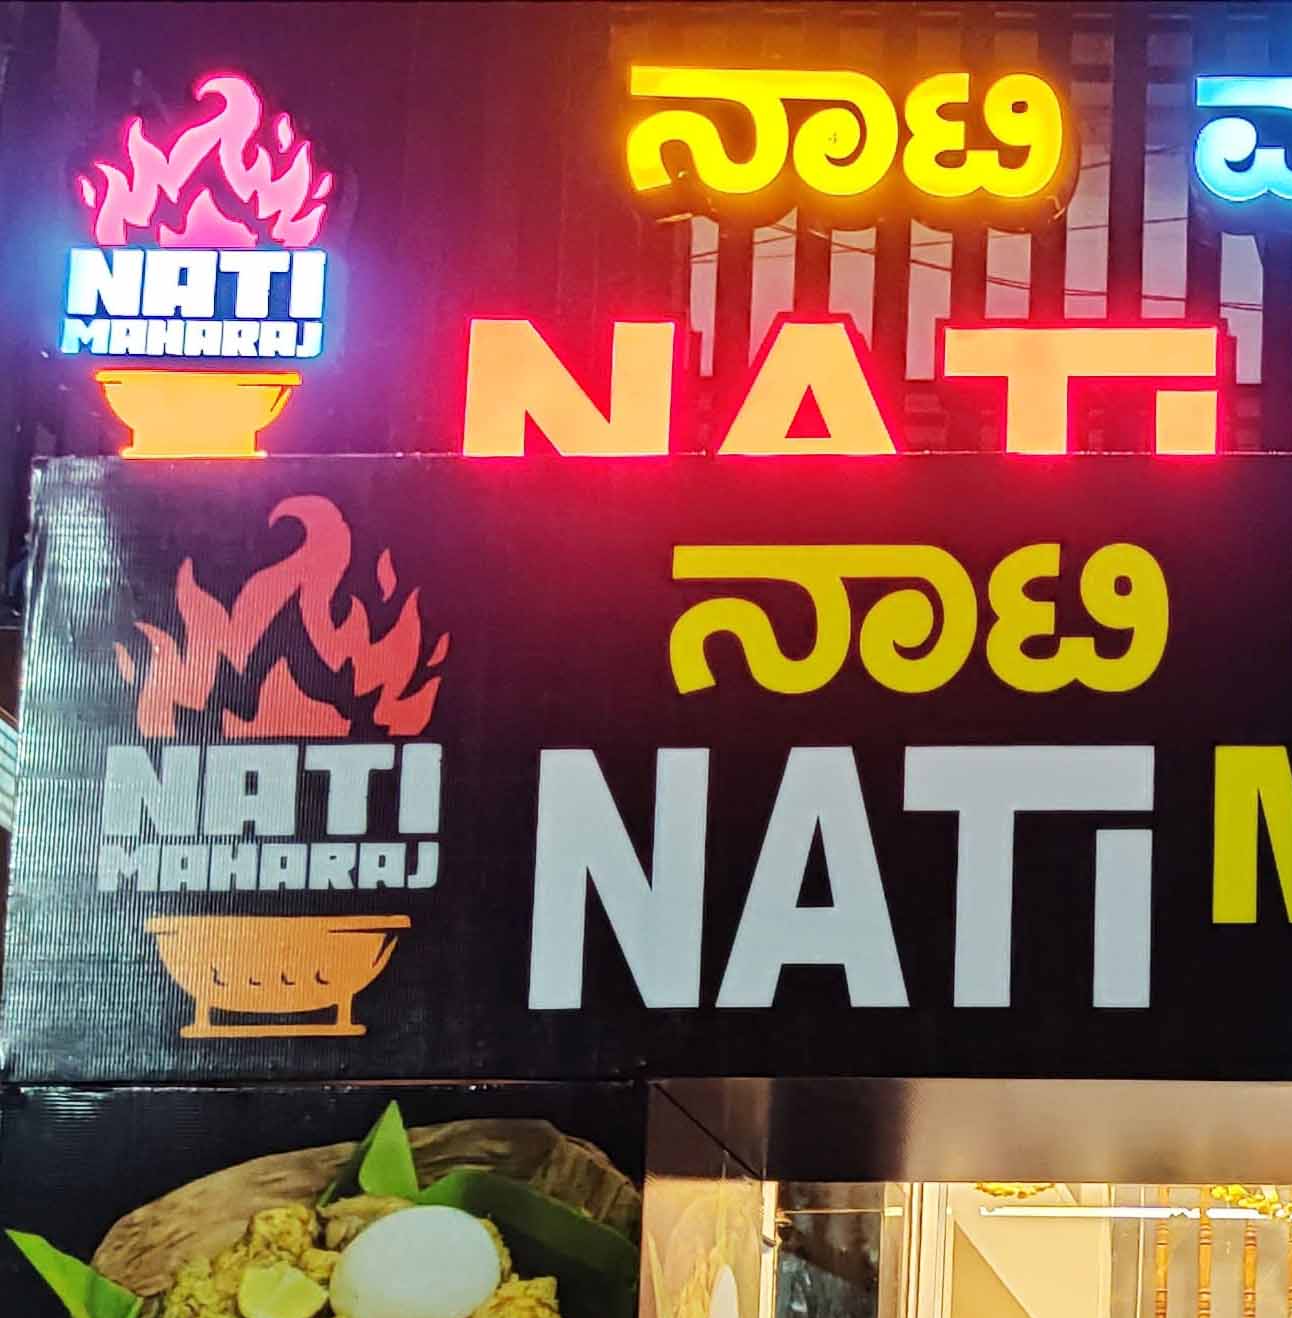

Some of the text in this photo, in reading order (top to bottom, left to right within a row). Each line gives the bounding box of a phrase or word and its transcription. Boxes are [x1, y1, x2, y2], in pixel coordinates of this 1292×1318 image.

[626, 66, 1062, 199] ನಾಟಿ
[66, 249, 327, 318] NATI
[61, 318, 323, 357] MAHARAJ
[669, 543, 1169, 695] ನಾಟಿ
[103, 743, 443, 836] NATI
[99, 842, 438, 891] MAHARAJ
[528, 746, 1155, 1011] NATI
